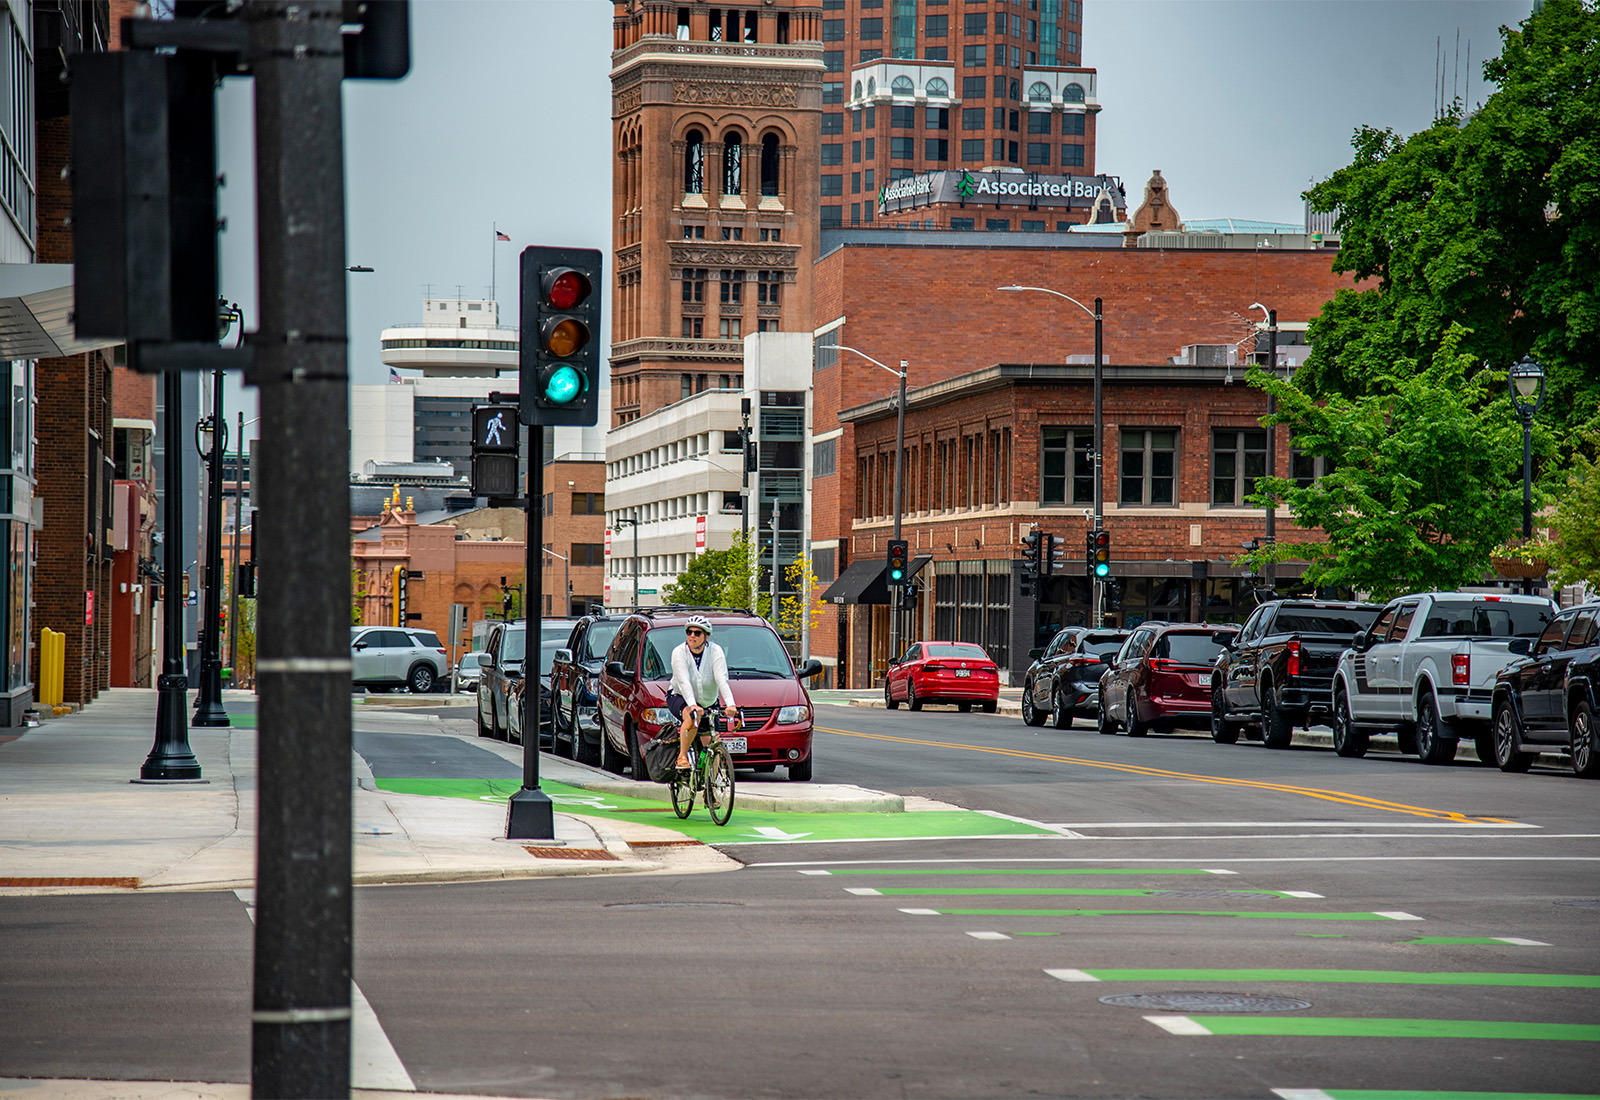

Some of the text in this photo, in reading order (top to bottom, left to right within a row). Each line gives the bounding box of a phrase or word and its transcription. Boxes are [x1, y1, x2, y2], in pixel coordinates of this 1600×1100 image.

[884, 179, 931, 202] Associated Bank
[977, 177, 1072, 198] Associated
